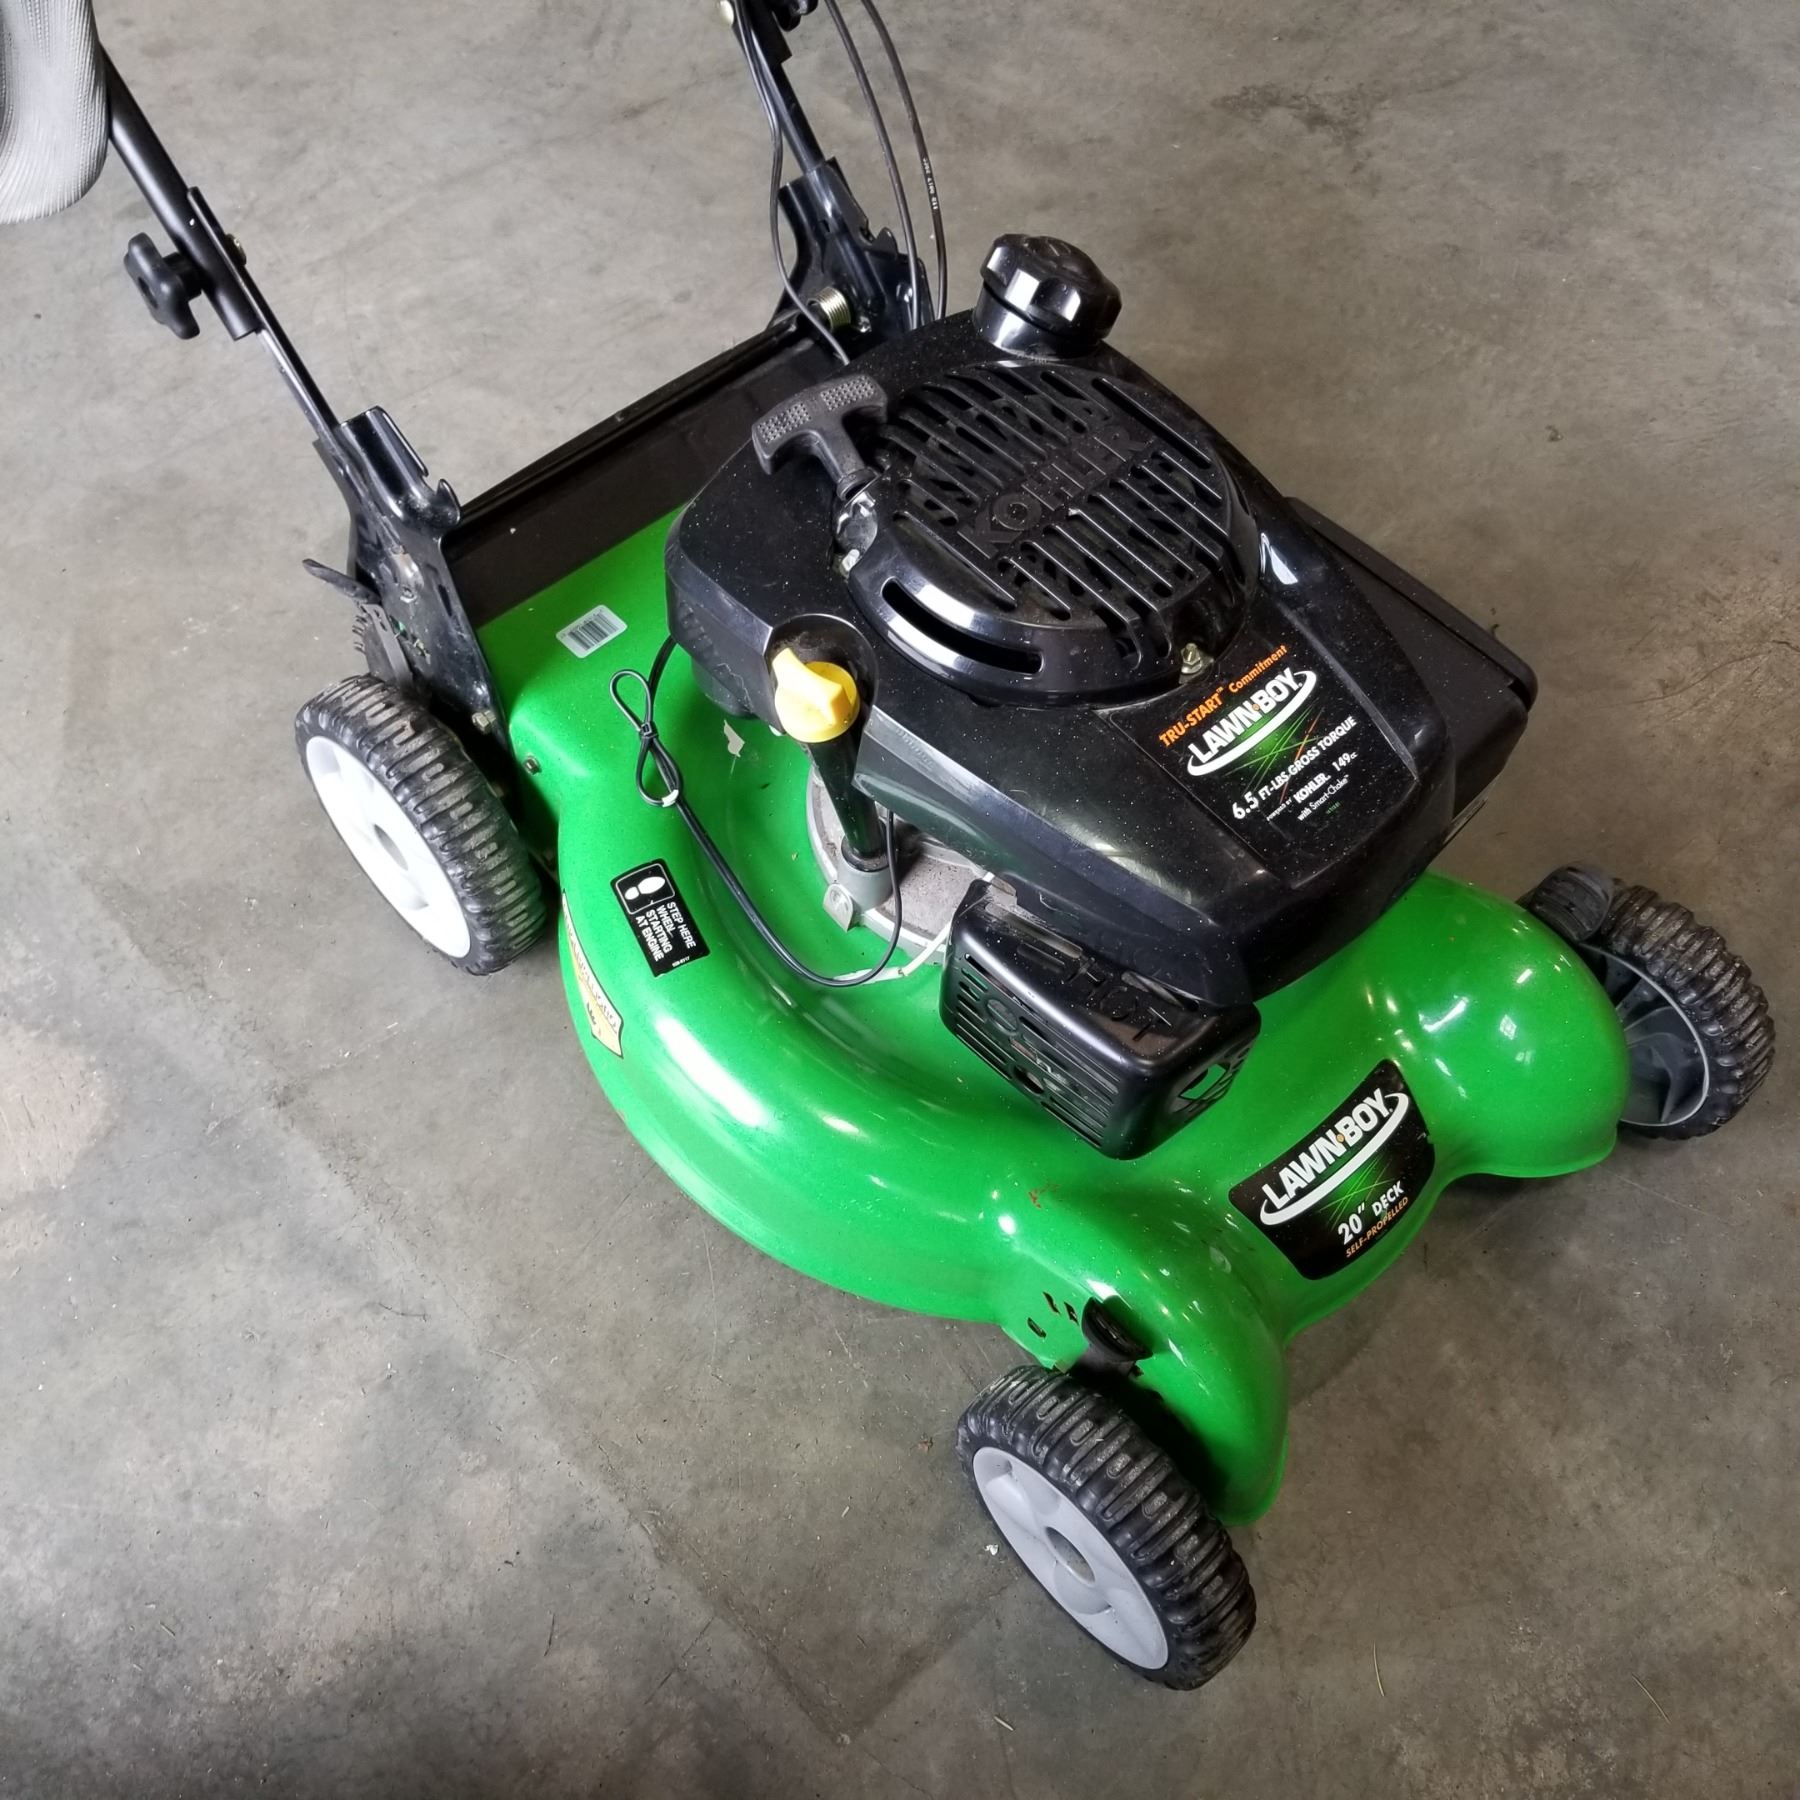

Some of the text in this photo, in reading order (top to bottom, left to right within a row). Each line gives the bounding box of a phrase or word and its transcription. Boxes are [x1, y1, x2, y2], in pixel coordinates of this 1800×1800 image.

[957, 426, 1146, 560] KOHLER
[1228, 645, 1287, 692] Commitment
[1232, 791, 1259, 819] 6.5
[1288, 746, 1320, 775] GROSS
[1317, 716, 1357, 750] TORQUE
[1293, 773, 1331, 803] KOHLER
[1298, 807, 1312, 821] with
[636, 915, 665, 961] AT ENGINE
[646, 909, 673, 953] STARTING
[656, 904, 676, 932] WHEN
[667, 901, 684, 923] STEP
[678, 924, 697, 949] HERE
[1338, 1180, 1405, 1245] 20" DECK
[1346, 1196, 1409, 1258] SELF-PROPELLED
